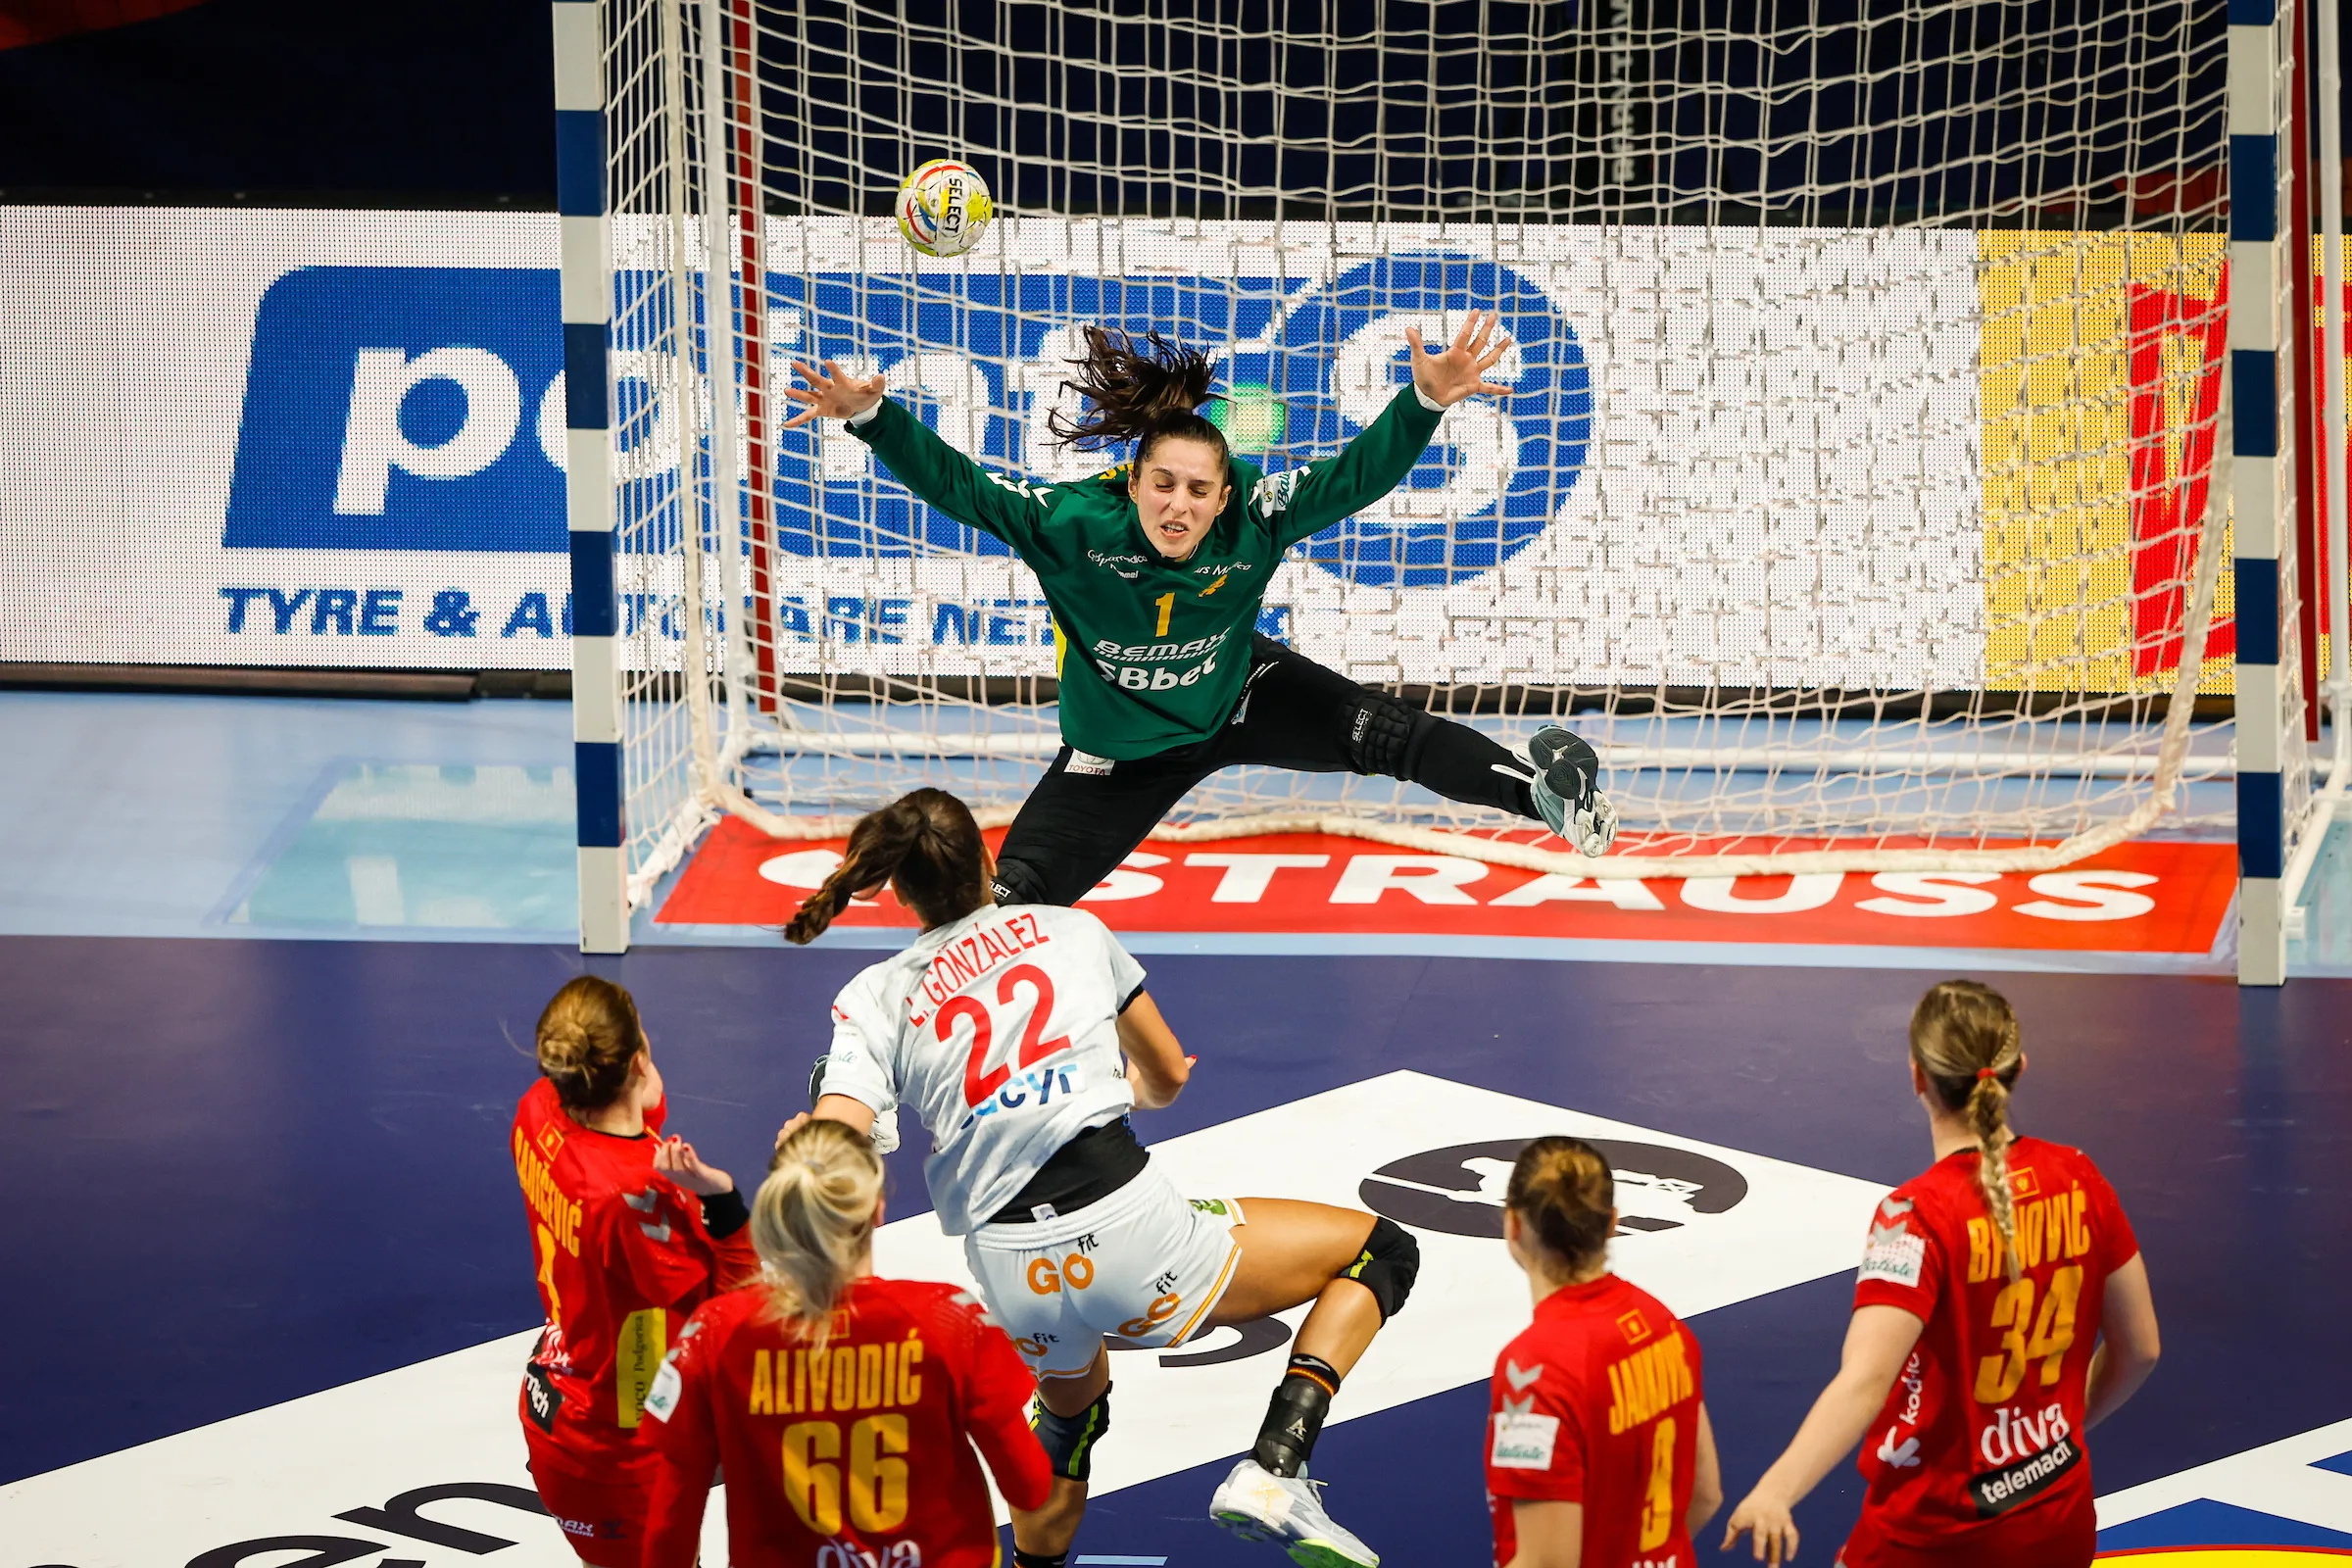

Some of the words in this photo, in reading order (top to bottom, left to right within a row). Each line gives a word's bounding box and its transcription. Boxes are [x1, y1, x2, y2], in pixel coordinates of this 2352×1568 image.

[944, 178, 962, 233] SELECT
[219, 588, 403, 635] TYRE
[424, 587, 481, 637] &
[1154, 592, 1175, 637] 1
[1351, 708, 1369, 742] SELECT
[1068, 764, 1106, 776] TOYOTA
[990, 880, 1012, 898] LECT
[1080, 851, 2159, 922] STRAUSS
[921, 912, 1051, 1006] GONZÁLEZ
[934, 963, 1072, 1109] 22
[1077, 1232, 1100, 1255] fit
[1026, 1252, 1095, 1296] GO
[1155, 1270, 1178, 1296] fit
[1032, 1332, 1060, 1344] fit
[1117, 1292, 1182, 1338] GO
[1973, 1264, 2084, 1404] 34
[1011, 1337, 1049, 1357] O
[749, 1328, 924, 1415] ALIVODIĆ
[1980, 1402, 2071, 1466] diva
[781, 1413, 909, 1536] 66
